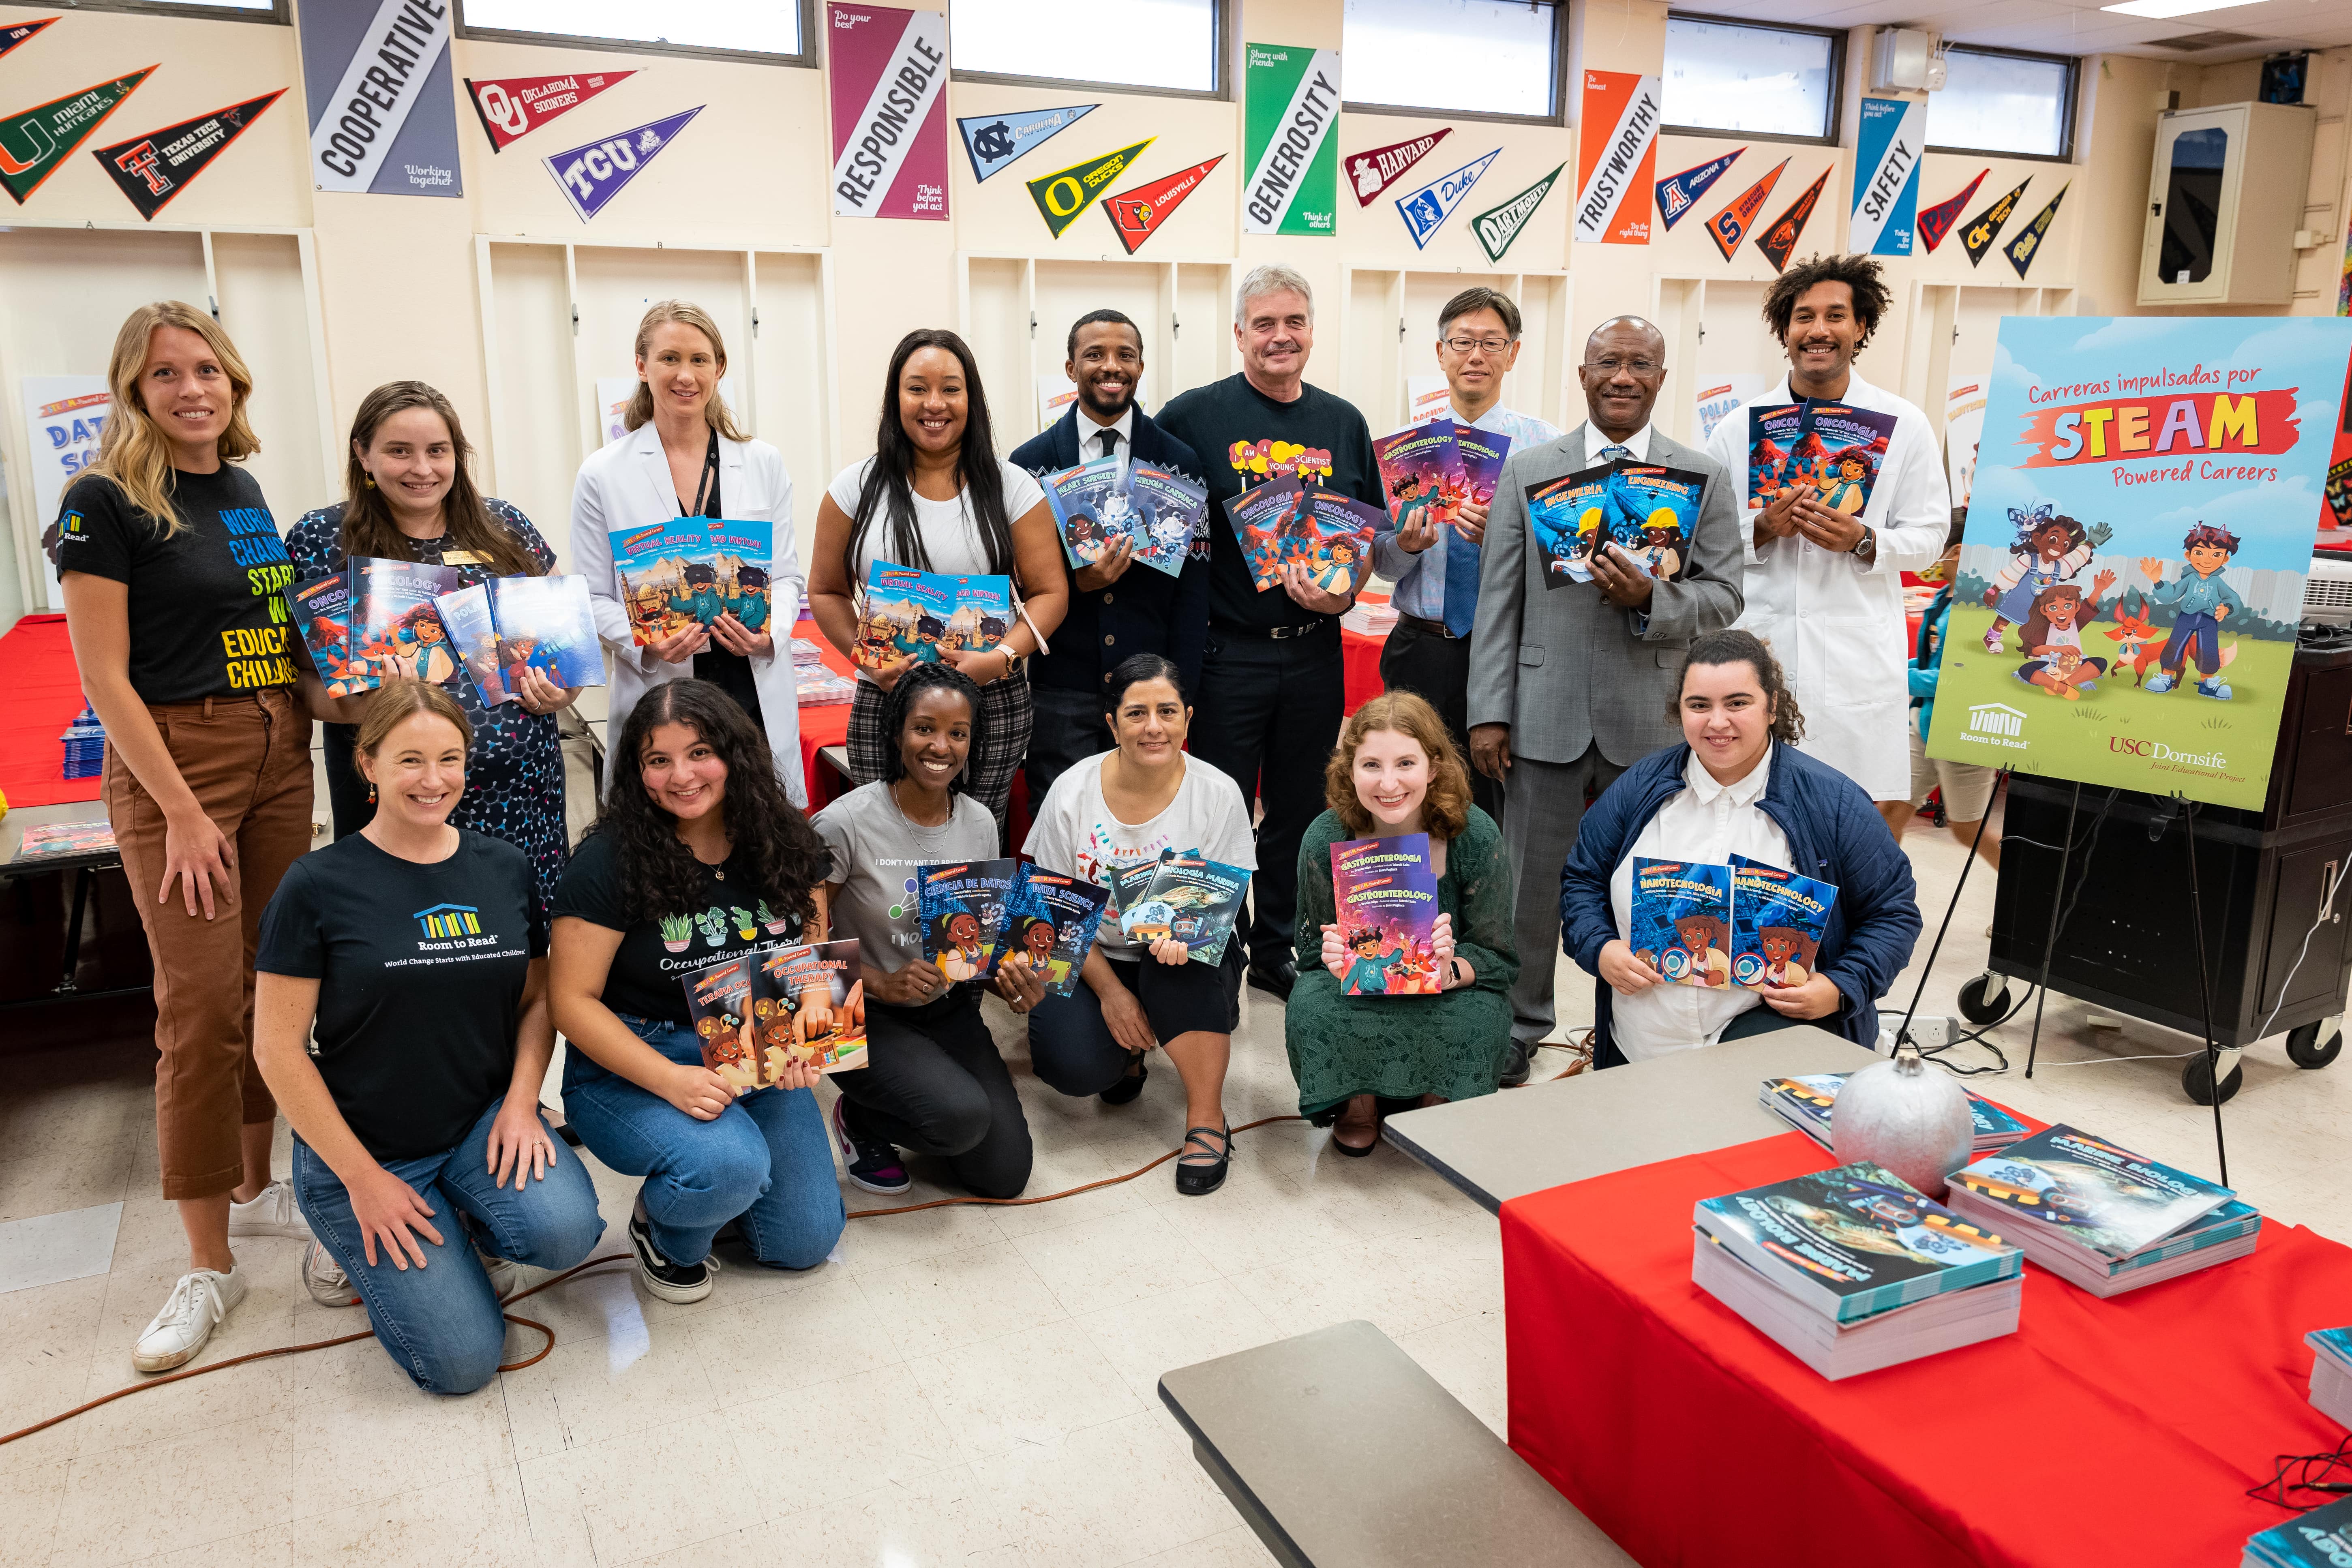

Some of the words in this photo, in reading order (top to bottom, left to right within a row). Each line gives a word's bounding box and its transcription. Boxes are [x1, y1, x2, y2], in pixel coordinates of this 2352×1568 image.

[834, 11, 848, 20] Do
[850, 14, 872, 26] your
[834, 18, 853, 29] best
[10, 28, 30, 39] UVA
[1249, 56, 1274, 68] friends
[1250, 50, 1271, 61] Share
[1272, 52, 1288, 61] with
[321, 0, 446, 178] COOPERATIVE
[521, 76, 580, 104] OKLAHOMA
[1587, 74, 1596, 83] Be
[1587, 81, 1607, 91] honest
[534, 92, 578, 114] SOONERS
[1879, 104, 1896, 114] before
[836, 36, 943, 208] RESPONSIBLE
[1015, 112, 1063, 140] CAROLINA
[161, 133, 197, 157] TEXAS
[193, 119, 221, 138] TECH
[168, 128, 226, 167] UNIVERSITY
[1248, 70, 1337, 225] GENEROSITY
[405, 164, 452, 178] Working
[563, 139, 637, 201] TCU
[1083, 154, 1124, 184] OREGON
[1376, 137, 1434, 182] HARVARD
[1579, 93, 1658, 232] TRUSTWORTHY
[409, 174, 453, 188] together
[1089, 162, 1124, 188] DUCKS
[1441, 170, 1474, 202] Duke
[1689, 162, 1720, 189] ARIZONA
[1865, 139, 1913, 221] SAFETY
[916, 192, 942, 203] before
[917, 184, 942, 195] Think
[1155, 175, 1196, 207] LOUISVILLE
[1665, 179, 1691, 219] A
[1738, 183, 1763, 212] SYRACUSE
[913, 202, 929, 213] you
[1743, 190, 1766, 218] ORANGE
[1988, 195, 2013, 222] GEORGIA
[1996, 206, 2011, 224] TECH
[1302, 212, 1323, 221] Think
[1324, 212, 1332, 222] of
[1630, 222, 1639, 230] Do
[1718, 210, 1742, 246] S
[1619, 229, 1633, 238] right
[1633, 230, 1648, 239] thing
[1894, 229, 1910, 238] Follow
[2029, 379, 2111, 405] Carreras
[2117, 364, 2220, 396] impulsadas
[2228, 366, 2263, 391] por
[1699, 398, 1739, 421] POLAR
[1815, 417, 1878, 440] ONCOLOGÍA
[2050, 394, 2260, 462] STEAM
[1295, 454, 1330, 466] SCIENTIST
[1383, 436, 1453, 461] GASTROENTEROLOGY
[1269, 462, 1295, 471] YOUNG
[2112, 460, 2193, 488] Powered
[2200, 461, 2278, 482] Careers
[1057, 480, 1081, 496] HEART
[1083, 471, 1116, 483] SURGERY
[1135, 476, 1163, 490] CIRUGÍA
[1165, 486, 1198, 509] CARDÍACA
[1544, 483, 1603, 507] INGENIERÍA
[1628, 476, 1689, 495] ENGINEERING
[1241, 491, 1294, 519] ONCOLOGÍA
[1314, 500, 1367, 527] ONCOLOGY
[218, 508, 277, 536] WORLD
[64, 533, 86, 542] Read
[625, 538, 662, 557] VIRTUAL
[664, 534, 702, 545] REALITY
[728, 536, 762, 549] VIRTUAL
[881, 578, 913, 589] VIRTUAL
[916, 583, 949, 601] REALITY
[973, 589, 1000, 601] VIRTUAL
[1960, 732, 1989, 744] Room
[1990, 736, 2001, 745] to
[2001, 737, 2027, 749] Read
[2110, 736, 2152, 757] USC
[2151, 742, 2226, 769] Dornsife
[2150, 760, 2170, 771] Joint
[2171, 763, 2218, 779] Educational
[2218, 770, 2246, 783] Project
[1341, 854, 1422, 871] GASTROENTEROLOGÍA
[925, 879, 964, 897] CIENCIA
[966, 878, 979, 888] DE
[981, 878, 1012, 889] DATOS
[1120, 869, 1154, 887] MARINE
[1205, 873, 1240, 890] MARINA
[1640, 878, 1722, 898] NANOTECNOLOGÍA
[1033, 883, 1056, 896] DATA
[1059, 891, 1095, 911] SCIENCE
[1347, 890, 1433, 904] GASTROENTEROLOGY
[1734, 877, 1825, 913] NANOTECHNOLOGY
[418, 940, 453, 951] Room
[454, 939, 467, 948] to
[467, 934, 497, 947] Read
[384, 958, 408, 968] World
[409, 957, 434, 965] Change
[471, 951, 501, 960] Educated
[660, 943, 760, 970] Occupational
[773, 960, 848, 978] OCCUPATIONAL
[788, 972, 835, 986] THERAPY
[698, 985, 733, 1007] TERAPIA
[2050, 1136, 2125, 1165] MARINE
[2126, 1162, 2204, 1199] BIOLOGY
[1735, 1196, 1800, 1244] BIOLOGY
[1793, 1242, 1872, 1282] MARINE
